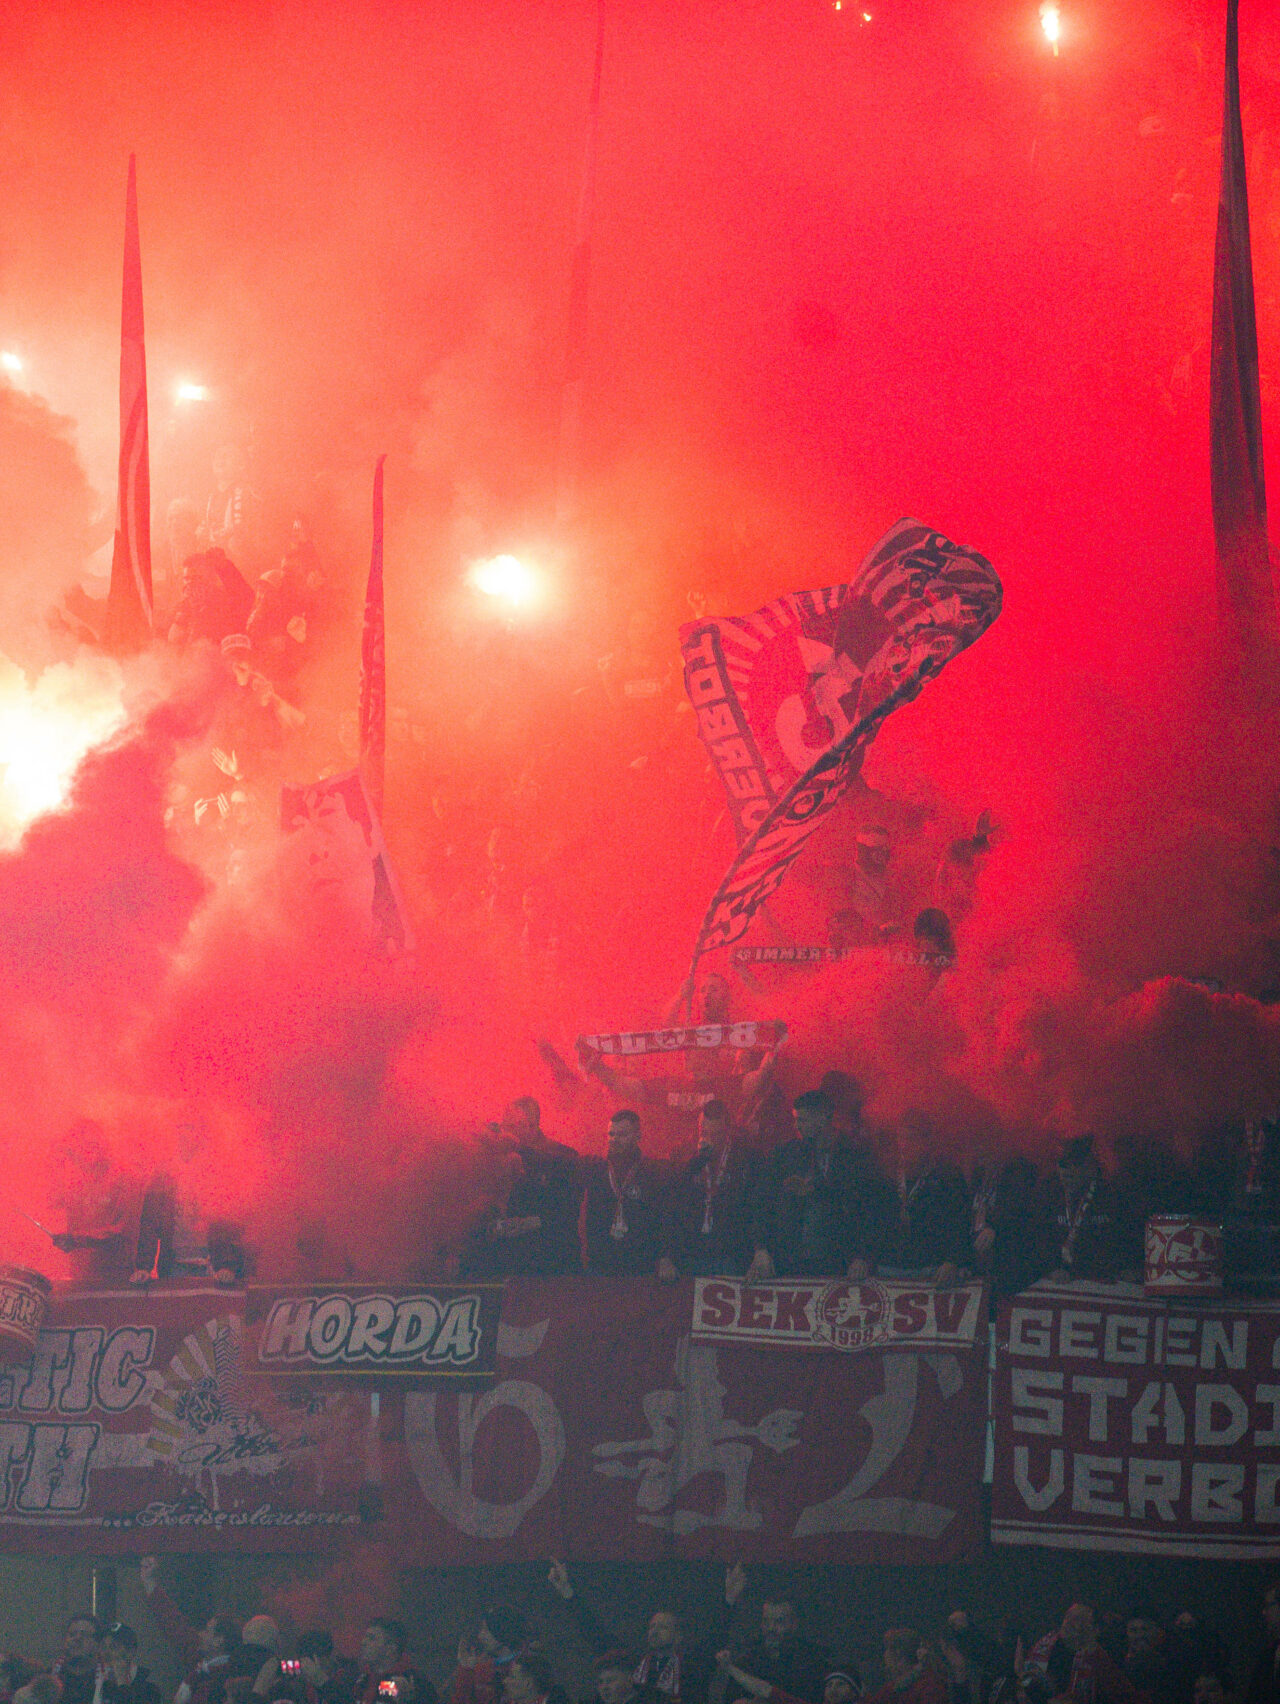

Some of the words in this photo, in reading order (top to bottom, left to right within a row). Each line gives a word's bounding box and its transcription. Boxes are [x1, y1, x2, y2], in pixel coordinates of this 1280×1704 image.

[261, 1295, 480, 1363] HORDA
[700, 1283, 814, 1331] SEK
[892, 1291, 973, 1334] SV
[831, 1325, 874, 1346] 1998
[1009, 1308, 1249, 1370] GEGEN
